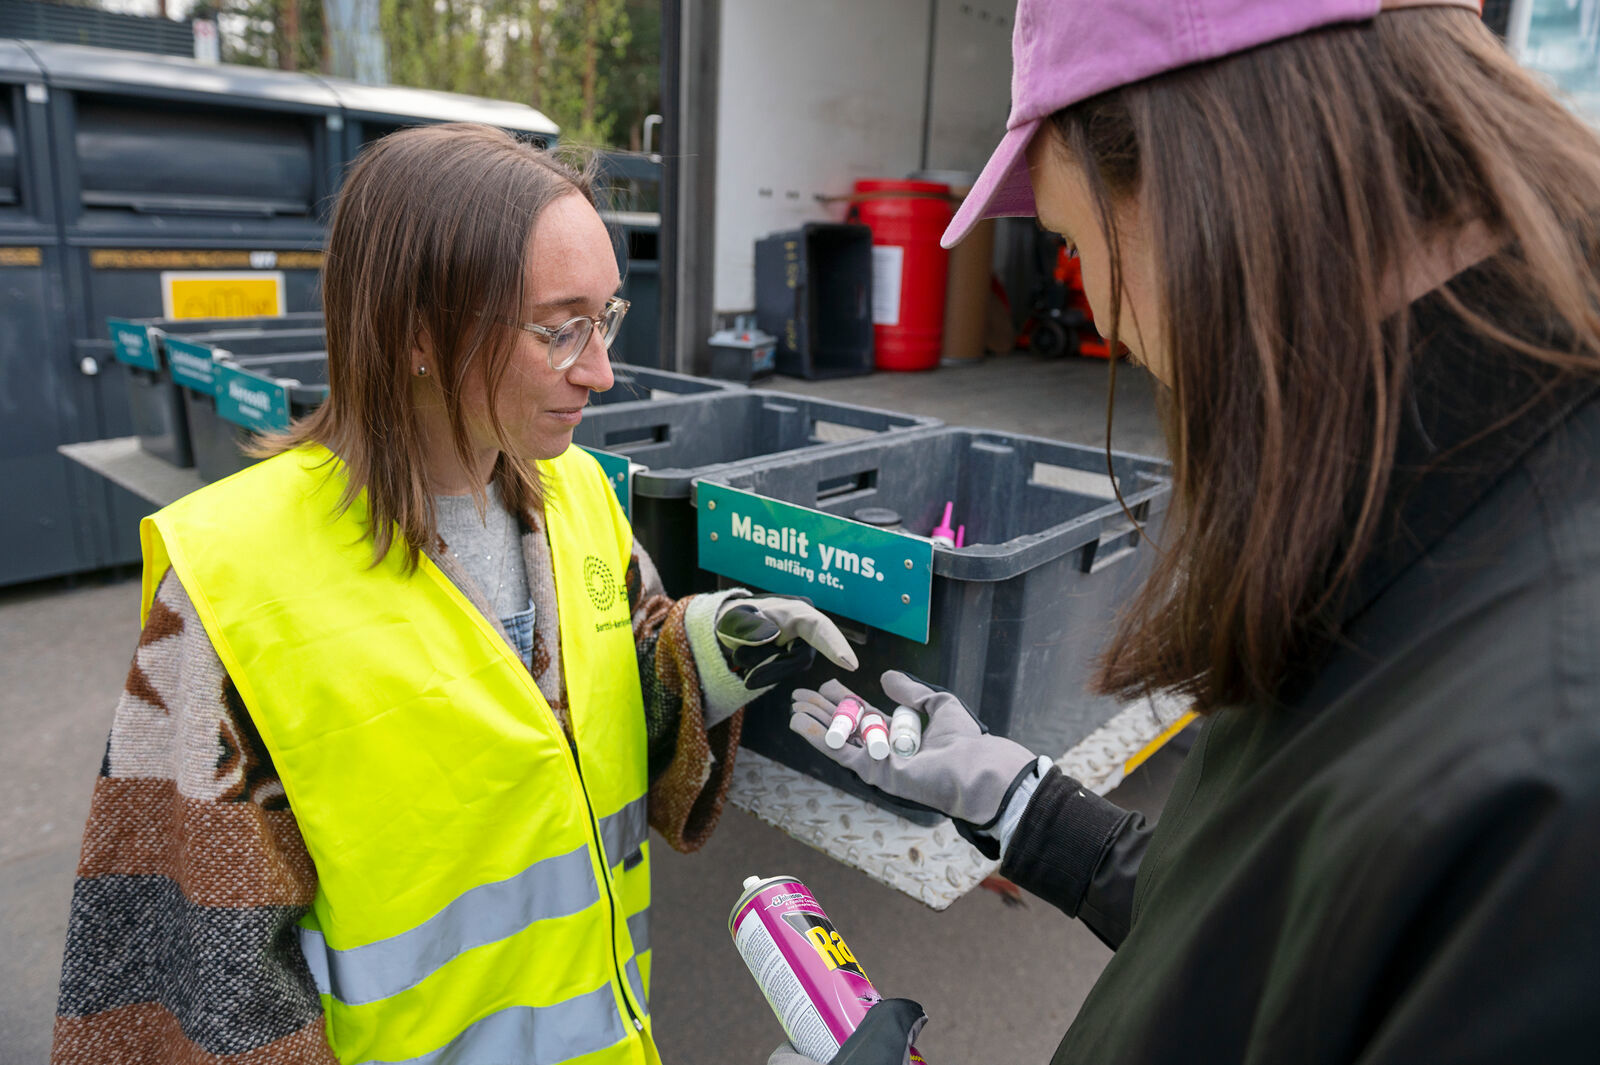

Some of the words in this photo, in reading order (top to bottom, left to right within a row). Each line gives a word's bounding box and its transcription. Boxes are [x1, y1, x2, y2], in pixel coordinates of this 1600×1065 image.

[731, 512, 809, 558] Maalit
[818, 543, 885, 582] yms.
[765, 555, 815, 583] malfärg
[818, 573, 844, 590] etc.
[805, 926, 866, 980] Ra
